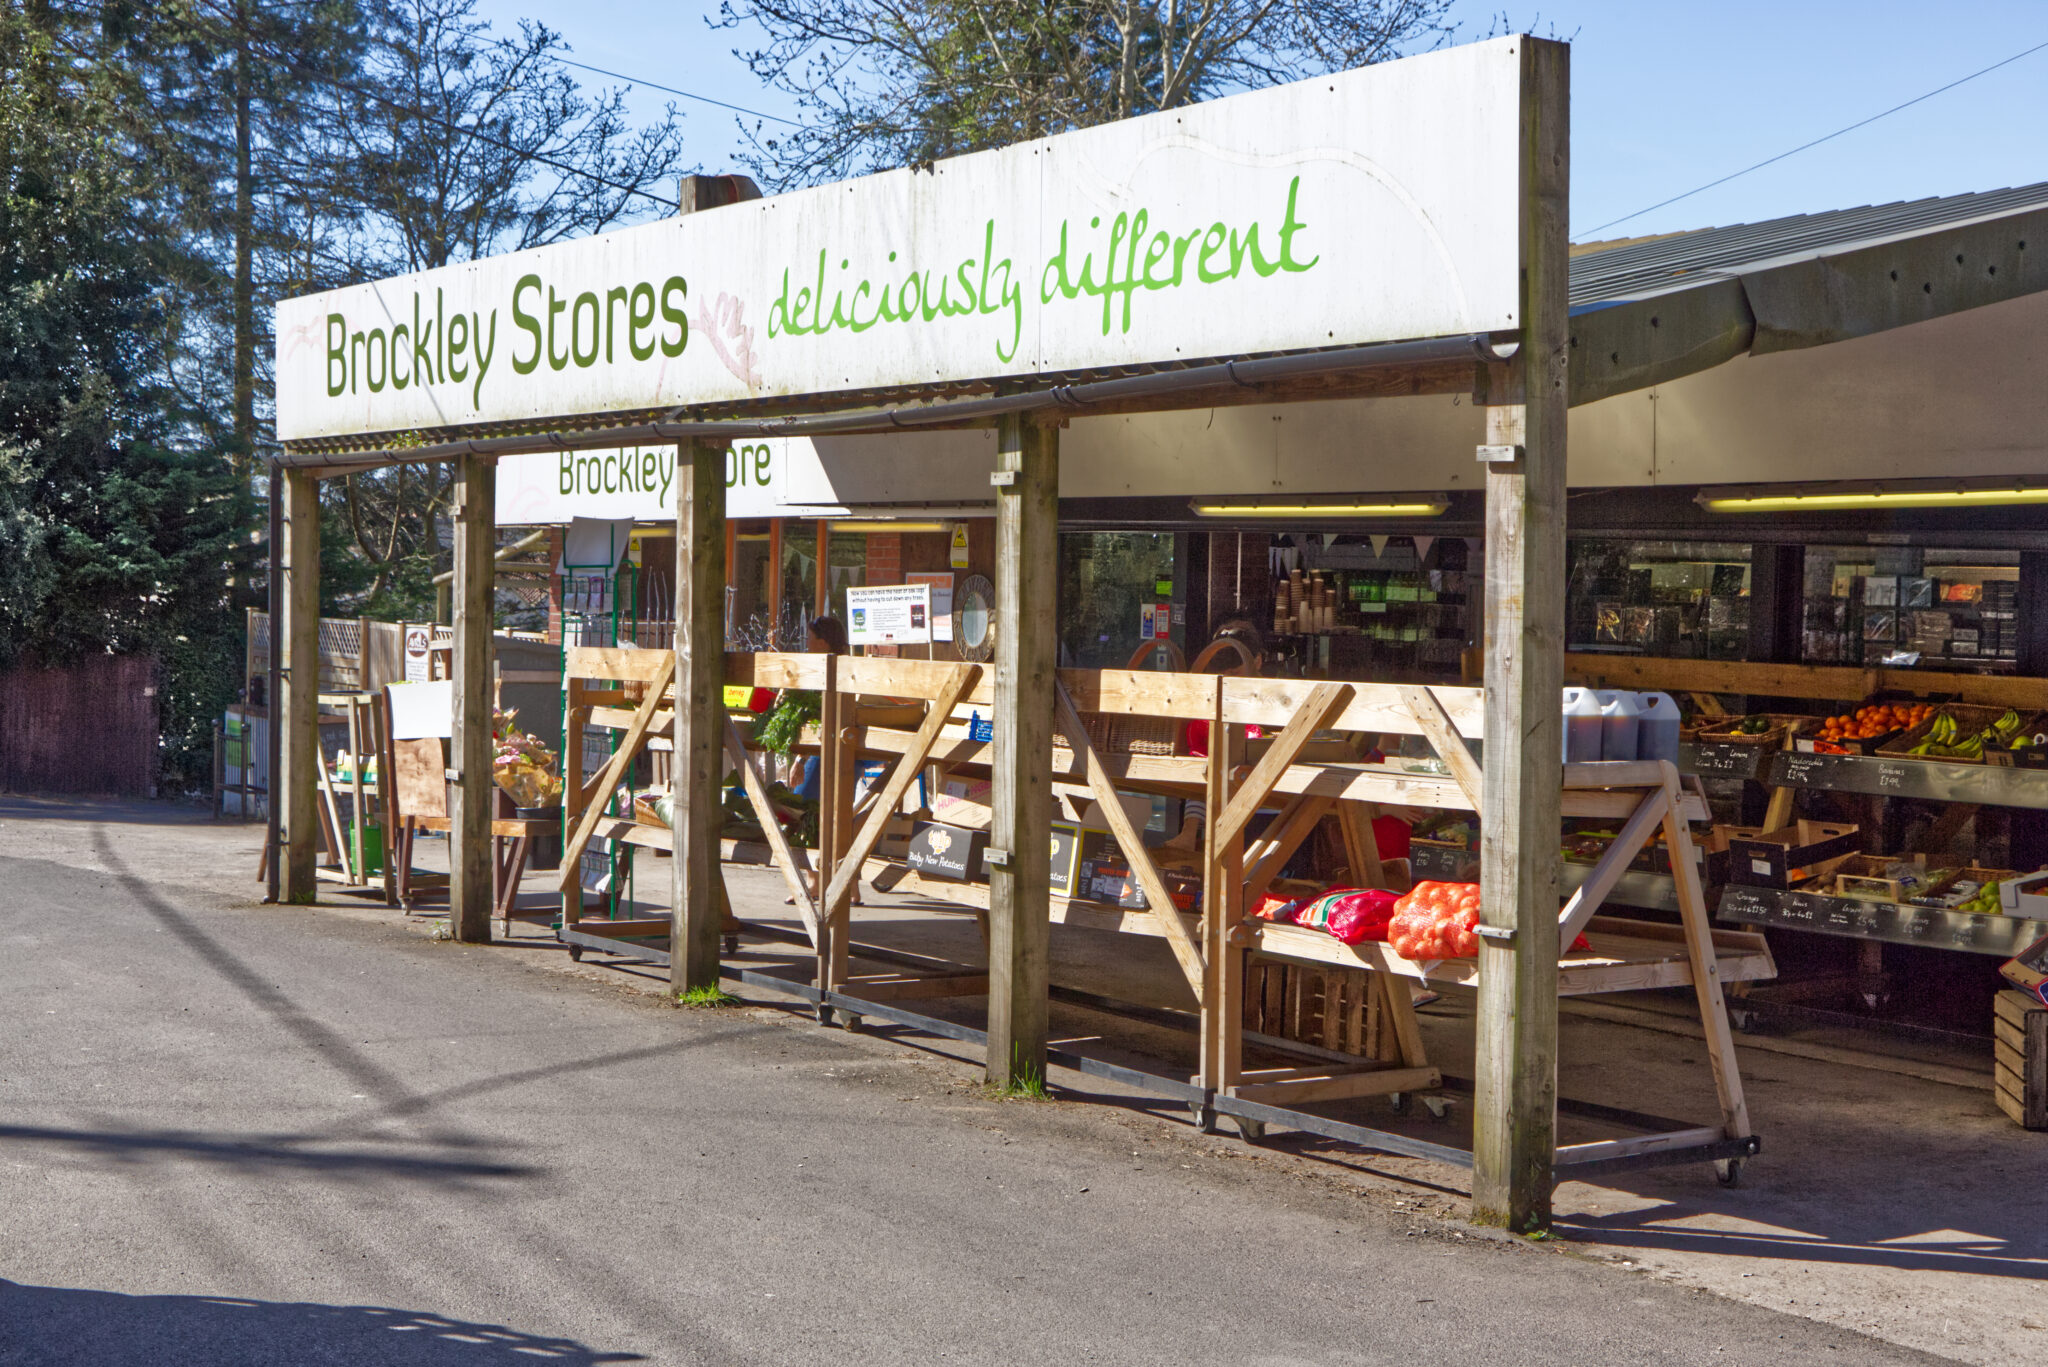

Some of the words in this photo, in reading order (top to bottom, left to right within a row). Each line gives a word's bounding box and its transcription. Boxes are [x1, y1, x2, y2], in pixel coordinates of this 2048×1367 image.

[768, 218, 1022, 365] deliciously
[1041, 175, 1320, 336] different
[327, 286, 496, 410] Brockley
[512, 274, 689, 375] Stores
[559, 446, 674, 509] Brockley
[908, 851, 924, 867] Baby
[925, 853, 938, 865] New
[938, 855, 965, 871] Potatoes
